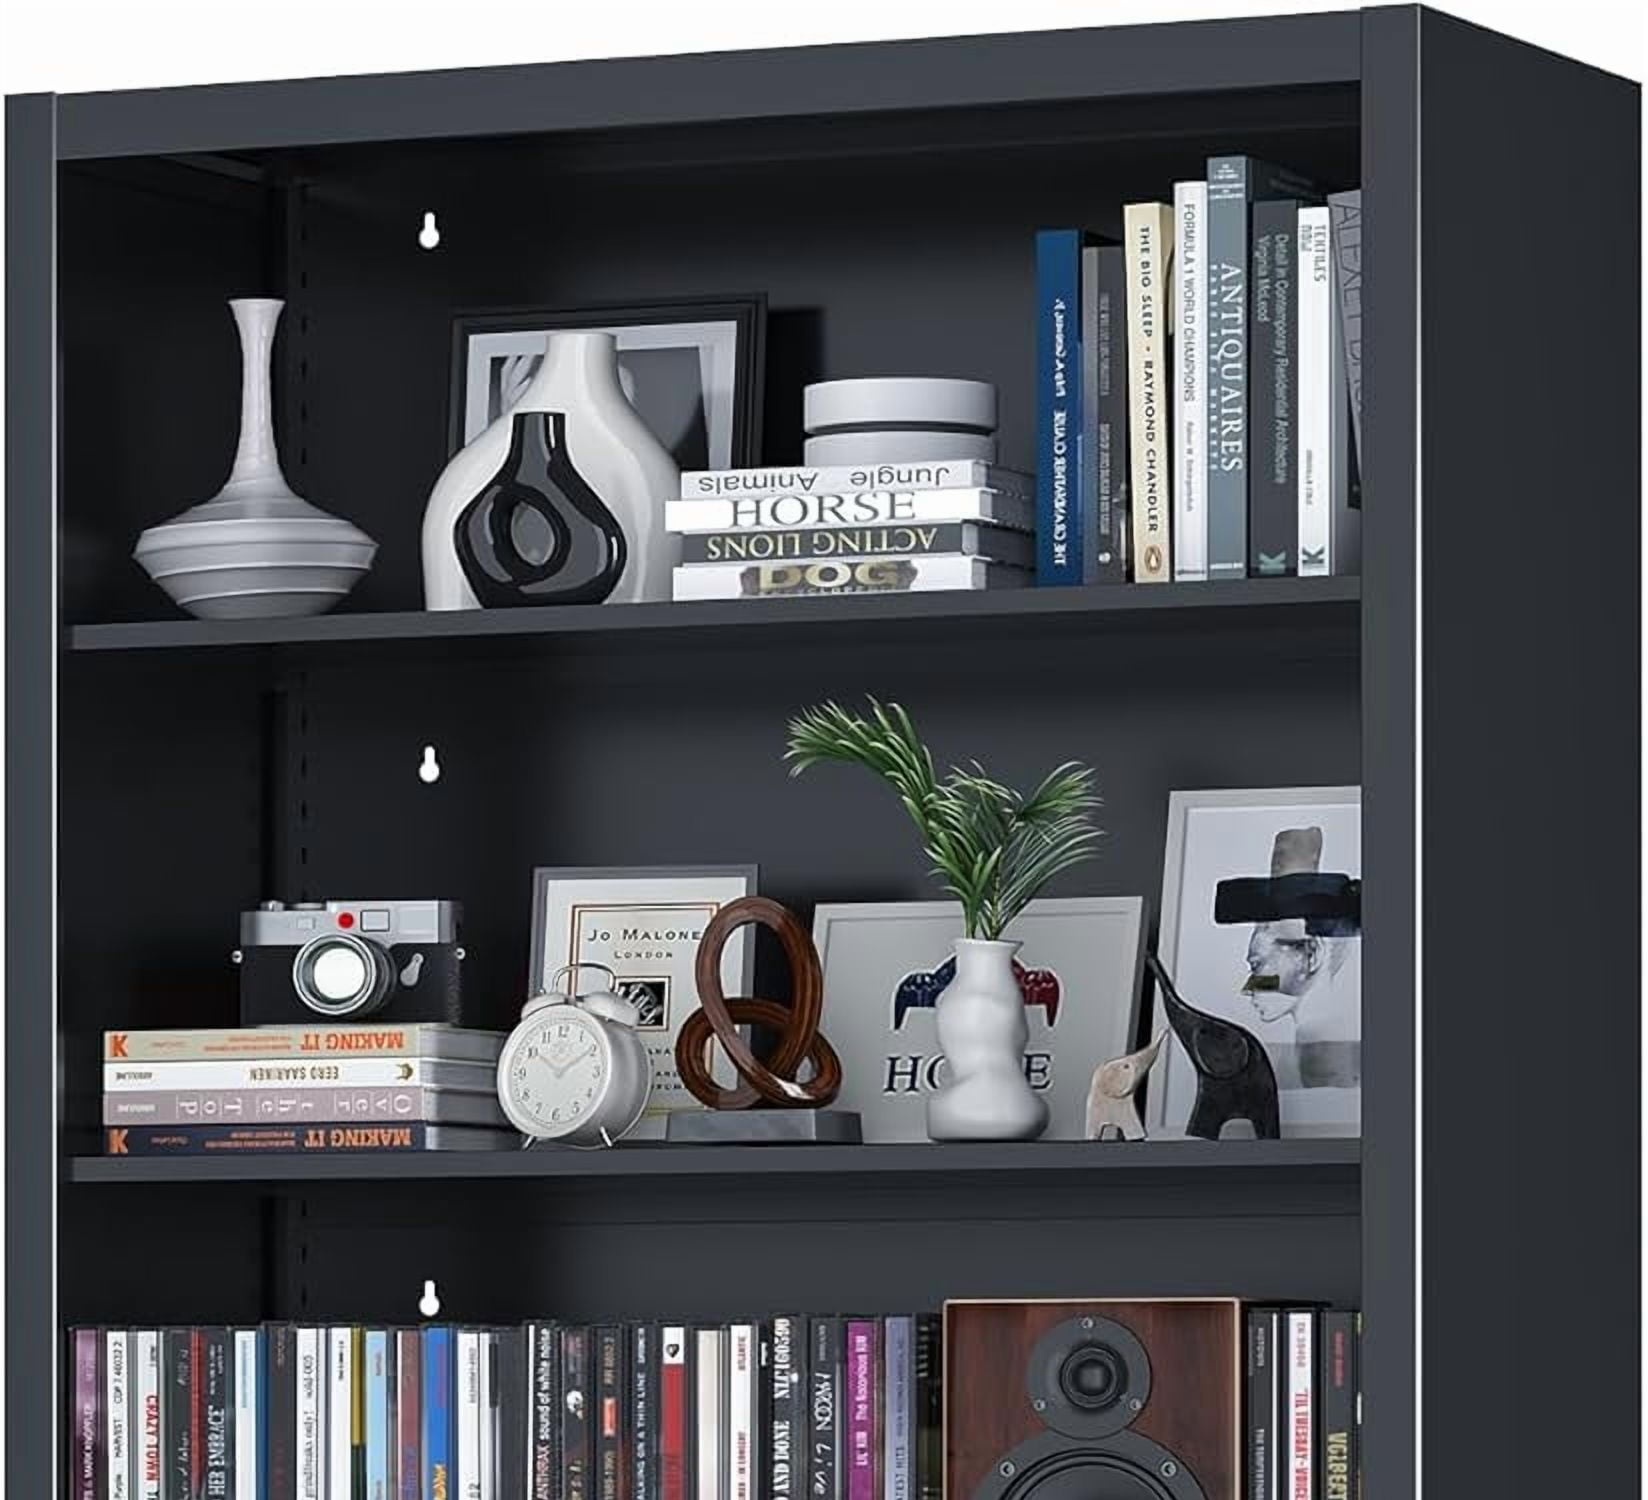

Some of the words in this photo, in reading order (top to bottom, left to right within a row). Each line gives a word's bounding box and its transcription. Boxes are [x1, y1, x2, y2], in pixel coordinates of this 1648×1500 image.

[1140, 227, 1151, 257] THE
[1183, 203, 1196, 266] FORMULA
[1276, 234, 1289, 264] Detail
[1142, 295, 1153, 337] SLEEP
[1183, 278, 1196, 325] WORLD
[1183, 328, 1196, 402] CHAMPIONS
[1217, 262, 1243, 471] ANTIQUAIRES
[1144, 360, 1156, 441] RAYMOND
[697, 471, 819, 492] Animals
[849, 465, 950, 489] Jungle
[1146, 448, 1158, 531] CHANDLER
[729, 492, 916, 528] HORSE
[706, 533, 800, 559] LIONS
[812, 527, 938, 554] ACTING
[758, 562, 898, 588] DOG
[300, 1034, 321, 1051] IT
[326, 1032, 404, 1049] MAKING
[249, 1066, 306, 1081] SAARINEN
[310, 1067, 339, 1080] EERO
[883, 1053, 1055, 1095] HE
[304, 1130, 325, 1148] IT
[331, 1128, 412, 1147] MAKING
[147, 1394, 160, 1437] CRAZY
[773, 1421, 790, 1460] DONE
[1295, 1411, 1308, 1459] TUESDAY
[147, 1443, 160, 1481] TOWN
[538, 1445, 549, 1500] ANTHRAX
[207, 1472, 225, 1495] HER
[773, 1465, 790, 1494] AND
